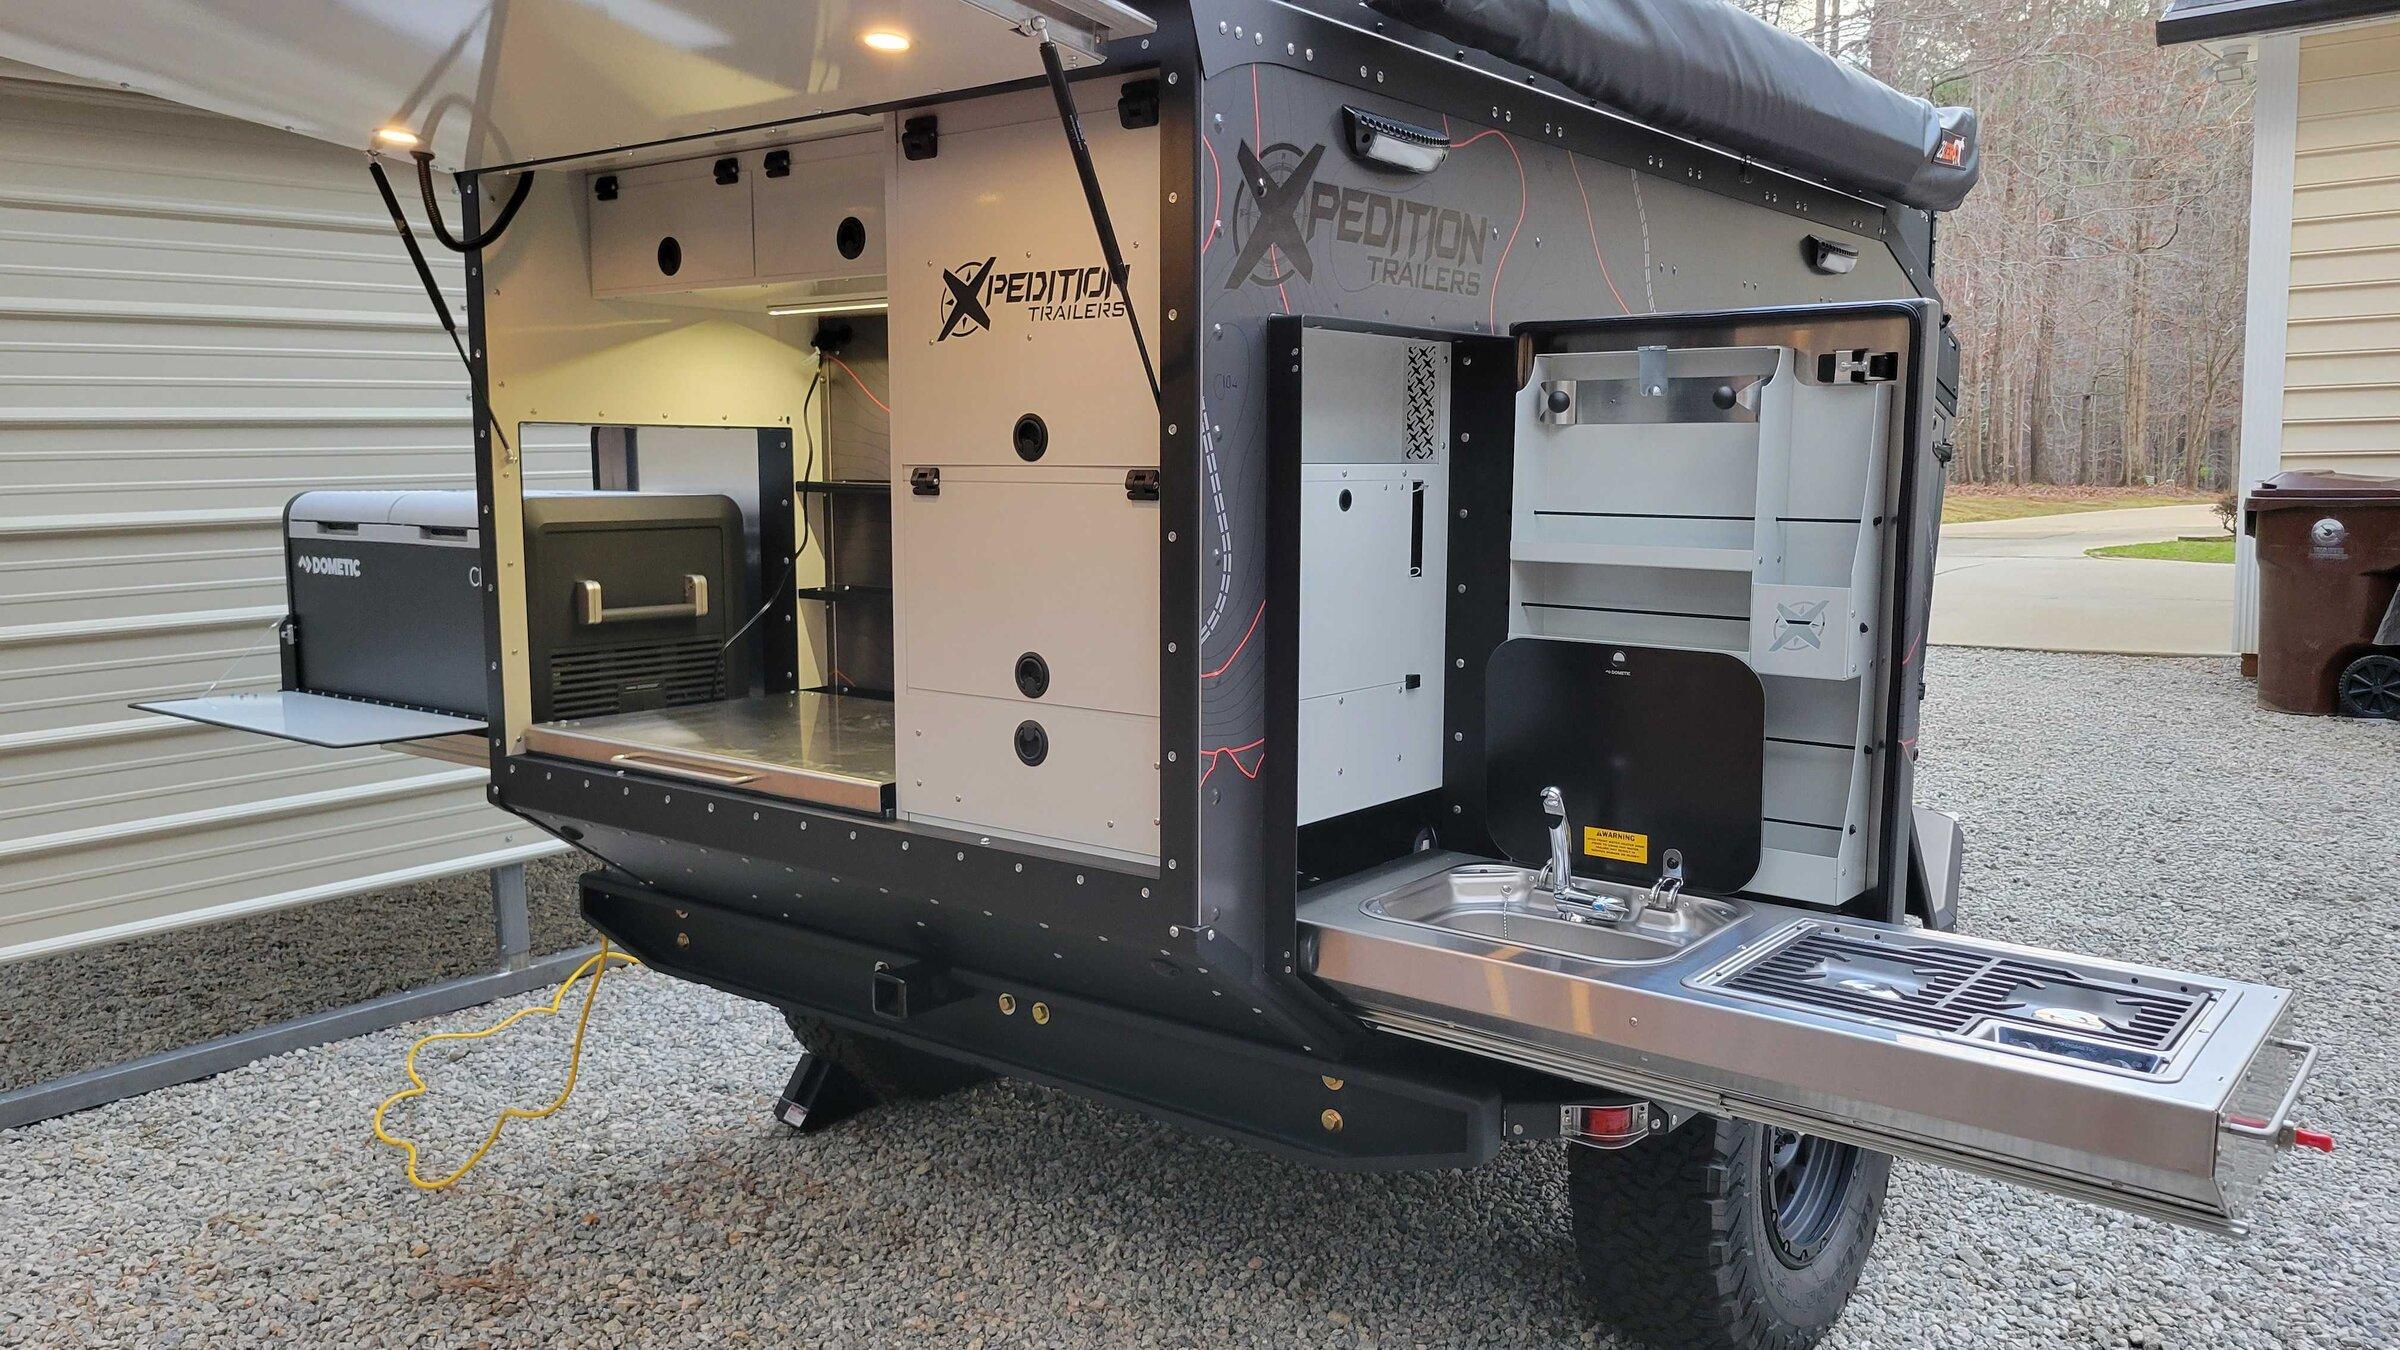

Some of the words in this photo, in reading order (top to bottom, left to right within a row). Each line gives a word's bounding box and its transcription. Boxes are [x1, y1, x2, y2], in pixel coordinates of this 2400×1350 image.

[1224, 138, 1487, 290] XPEDITION
[1367, 255, 1480, 297] TRAILERS
[1028, 302, 1126, 322] TRAILERS
[312, 556, 361, 577] DOMETIC
[1602, 830, 1635, 842] WARNING
